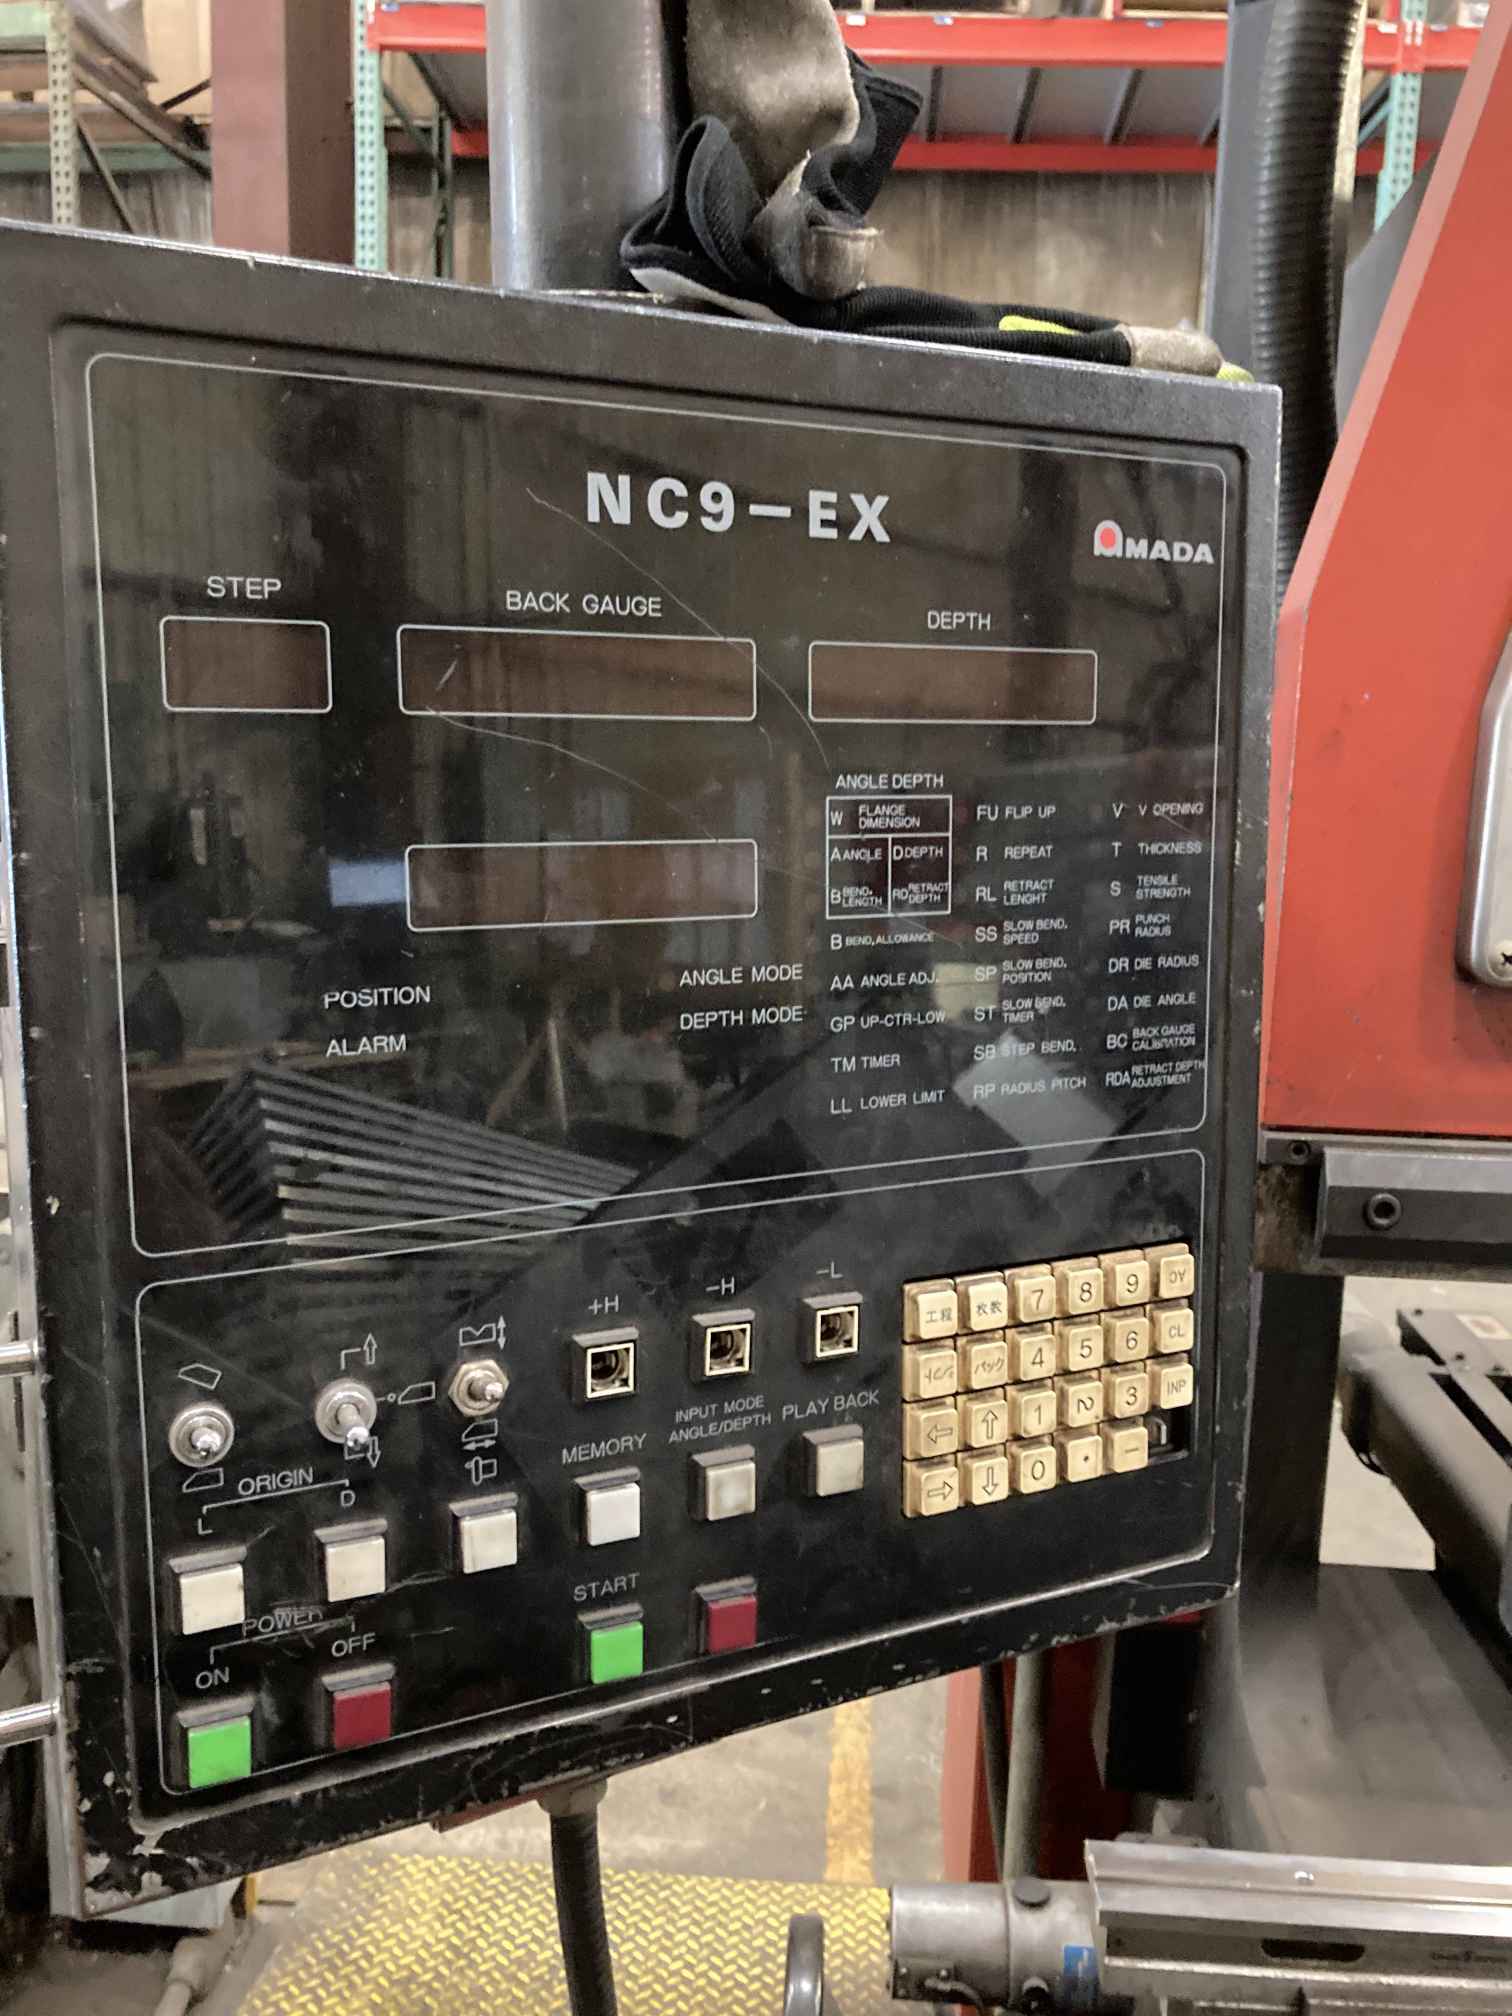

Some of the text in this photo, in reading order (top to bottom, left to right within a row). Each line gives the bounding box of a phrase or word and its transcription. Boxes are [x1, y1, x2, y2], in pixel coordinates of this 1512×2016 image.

[1093, 519, 1215, 564] AMADA
[207, 576, 281, 599] STEP
[506, 590, 662, 616] BACK GAUGE
[928, 610, 991, 631] DEPTH
[836, 773, 944, 789] ANGLE DEPTH
[831, 811, 843, 826] W
[859, 804, 906, 816] FLANGE
[976, 805, 1056, 821] FU FLIP UP
[1112, 802, 1204, 819] V V OPENING
[859, 816, 920, 829] DIMENSION
[831, 848, 882, 862] A ANGLE
[893, 845, 944, 860] D DEPTH
[976, 845, 1053, 861] R REPEAT
[1112, 840, 1202, 857] T THICKNESS
[908, 882, 949, 893] RETRACT
[1003, 879, 1054, 892] RETRACT
[1137, 873, 1179, 887] TENSILE
[831, 889, 841, 904] B
[893, 888, 909, 900] RD
[976, 886, 997, 902] RL
[1110, 881, 1121, 897] S
[1135, 887, 1191, 900] STRENGTH
[842, 896, 882, 908] LENGTH
[908, 894, 941, 904] DEPTH
[1003, 918, 1068, 932] SLOW BEND.
[1109, 919, 1130, 935] PR
[1135, 913, 1170, 925] PUNCH
[975, 926, 998, 943] SS
[1003, 932, 1039, 945] SPEED
[1135, 925, 1172, 938] RADIUS
[830, 934, 842, 950] B
[1002, 959, 1033, 971] SLOW
[1108, 955, 1200, 973] DR DIE RADIUS
[680, 964, 803, 987] ANGLE MODE
[830, 971, 939, 991] AA ANGLE ADJ.
[975, 966, 997, 982] SP
[1002, 971, 1052, 984] POSITION
[323, 986, 431, 1008] POSITION
[1002, 998, 1033, 1010] SLOW
[1107, 992, 1196, 1011] DA DIE ANGLE
[680, 1006, 803, 1030] DEPTH MODE
[830, 1009, 947, 1033] GP UP-CTR-LOW
[974, 1005, 997, 1022] ST
[1002, 1011, 1034, 1023] TIMER
[1132, 1024, 1196, 1039] BACK GAUGE
[325, 1034, 407, 1057] ALARM
[1106, 1033, 1128, 1049] BC
[974, 1044, 996, 1061] SB
[1000, 1043, 1035, 1057] STEP
[831, 1053, 901, 1073] TM TIMER
[1131, 1060, 1206, 1076] RETRACT DEPTH
[1106, 1072, 1131, 1087] RDA
[1131, 1073, 1192, 1088] ADJUSTMENT
[973, 1077, 1087, 1100] RP RADIUS PITCH
[830, 1089, 946, 1114] LL LOWER LIMIT
[1080, 1281, 1092, 1302] 8
[1126, 1274, 1138, 1294] 9
[587, 1294, 619, 1315] +H
[1032, 1289, 1044, 1310] 7
[1168, 1325, 1184, 1339] CL
[1080, 1338, 1092, 1358] 5
[1126, 1331, 1138, 1351] 6
[1032, 1348, 1044, 1368] 4
[1167, 1379, 1187, 1395] INP
[1126, 1386, 1138, 1406] 3
[675, 1395, 765, 1424] INPUT MODE
[782, 1390, 880, 1421] PLAY BACK
[1034, 1405, 1042, 1425] 1
[668, 1412, 772, 1443] ANGLE/DEPTH
[561, 1433, 647, 1465] MEMORY
[238, 1467, 314, 1496] ORIGIN
[340, 1490, 356, 1507] D
[198, 1518, 213, 1535] L
[573, 1572, 640, 1602] START
[331, 1632, 376, 1657] OFF
[196, 1667, 230, 1689] ON
